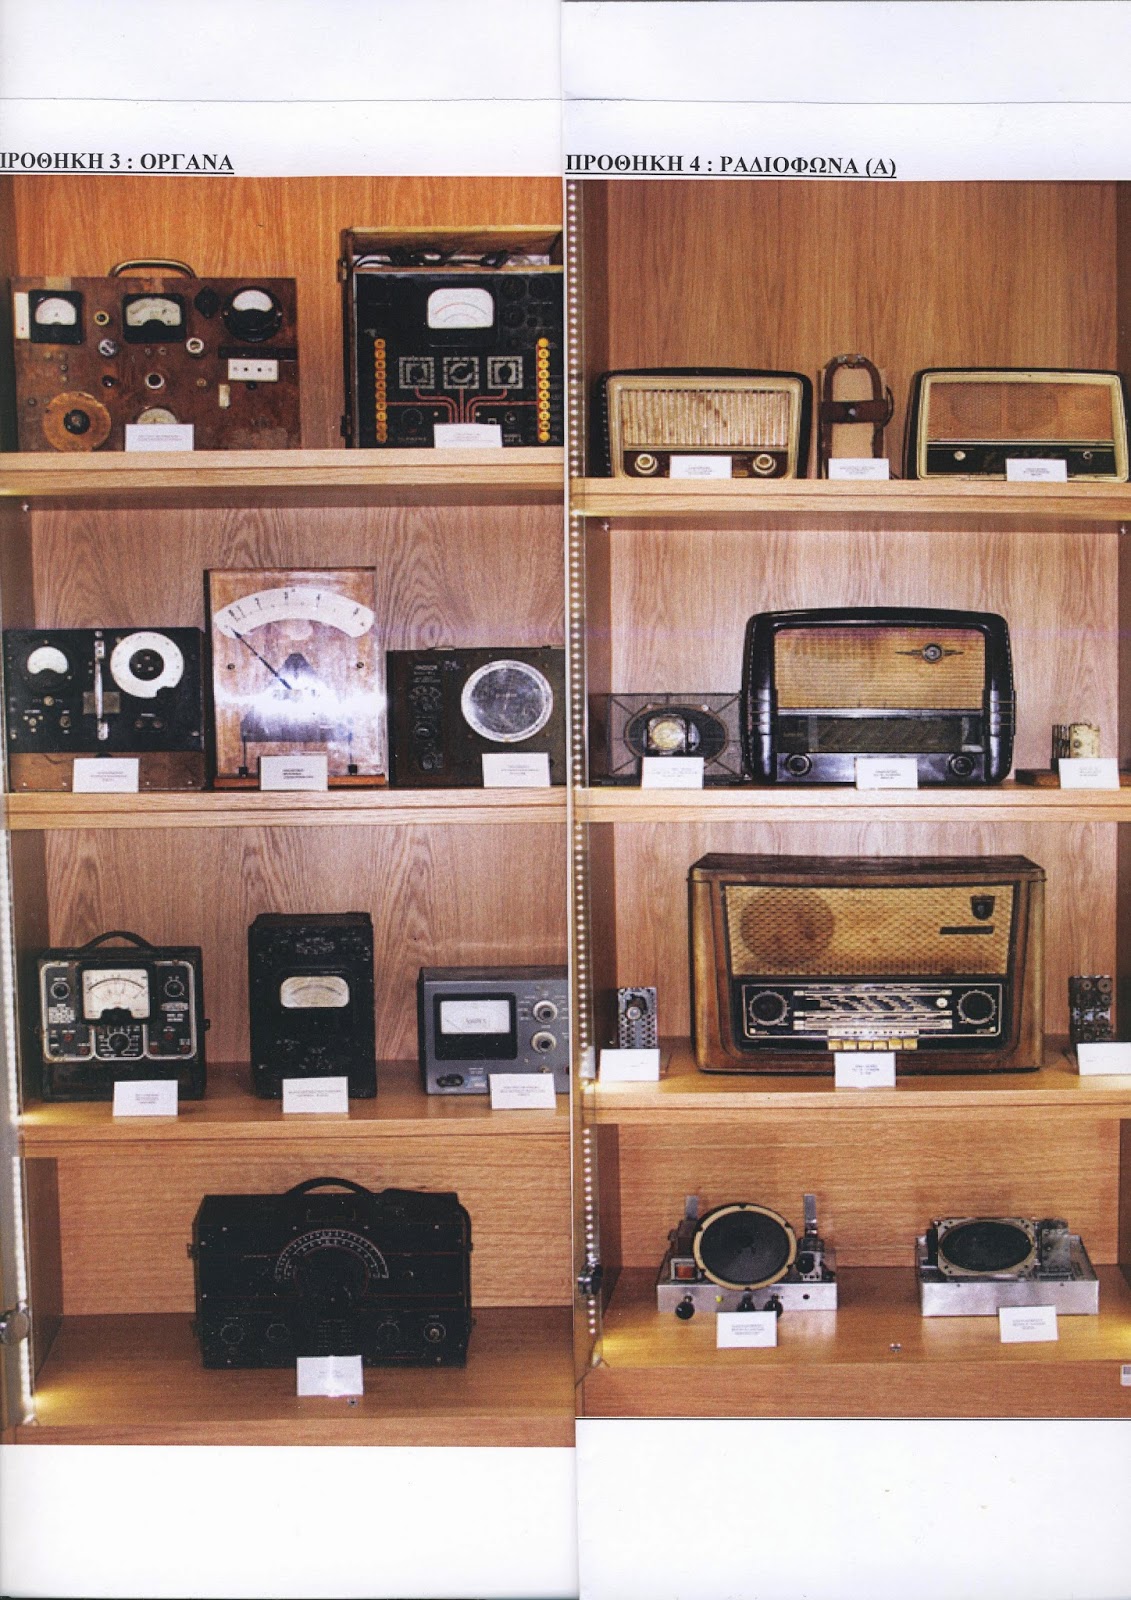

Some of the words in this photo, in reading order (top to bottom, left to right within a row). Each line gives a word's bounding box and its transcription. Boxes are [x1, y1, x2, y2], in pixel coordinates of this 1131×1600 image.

[109, 153, 121, 169] 3
[140, 153, 235, 170] ΟΡΓΑΝΑ
[566, 154, 684, 171] ΠΡΟΘΗΚΗ
[689, 155, 701, 171] 4
[720, 155, 859, 174] ΡΑΔΙΟΦΩΝΑ
[865, 158, 896, 177] (Α)
